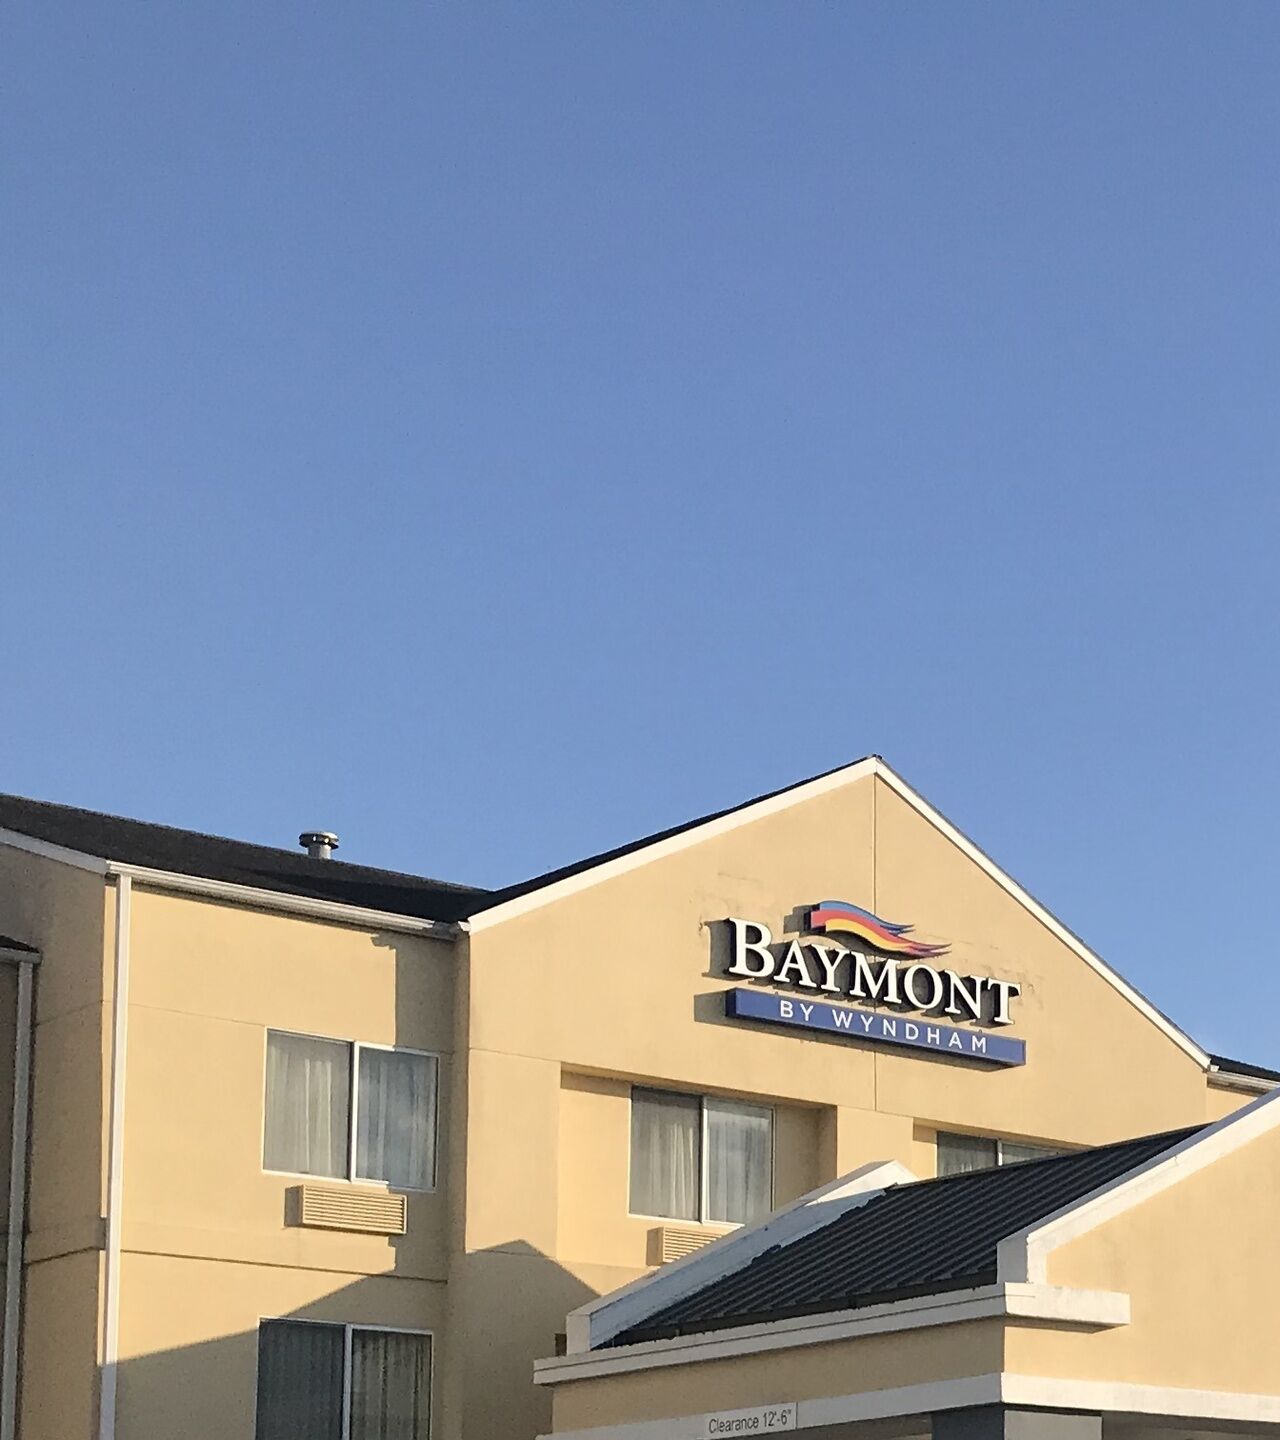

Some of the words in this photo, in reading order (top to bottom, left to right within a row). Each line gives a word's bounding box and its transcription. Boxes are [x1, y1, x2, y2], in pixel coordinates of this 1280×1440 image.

[728, 917, 1021, 1025] BAYMONT
[779, 1000, 814, 1022] BY
[832, 1009, 988, 1053] WYNDHAM
[708, 1416, 760, 1434] Clearance
